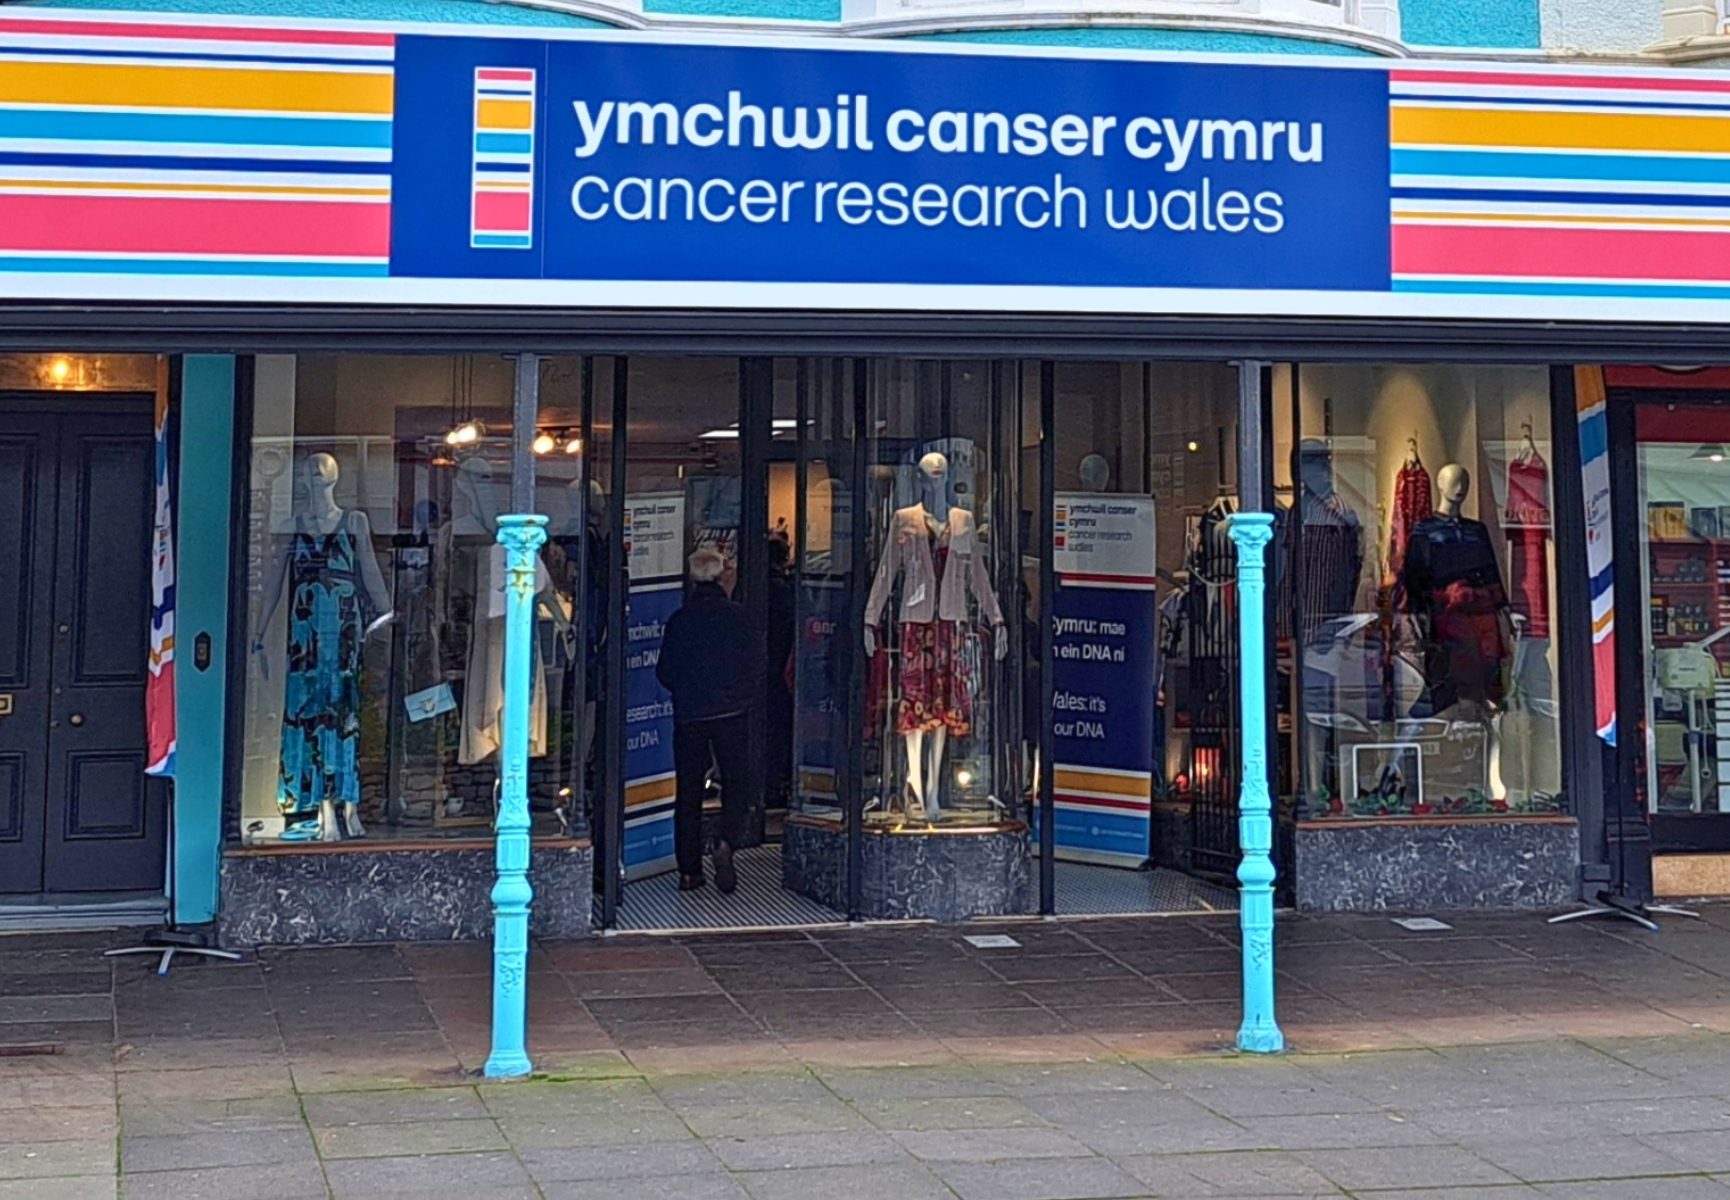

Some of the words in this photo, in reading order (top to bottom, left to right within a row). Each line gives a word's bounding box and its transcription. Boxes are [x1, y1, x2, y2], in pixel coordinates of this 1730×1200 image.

[572, 91, 874, 158] ymchwil
[885, 108, 1117, 156] canser
[1125, 115, 1323, 172] cymru
[571, 174, 804, 223] cancer
[815, 173, 1087, 227] research
[1105, 177, 1284, 233] wales
[1099, 622, 1126, 636] mae
[1060, 643, 1080, 659] ein
[1082, 644, 1112, 661] DNA
[1054, 722, 1075, 736] our
[1076, 721, 1105, 738] DNA
